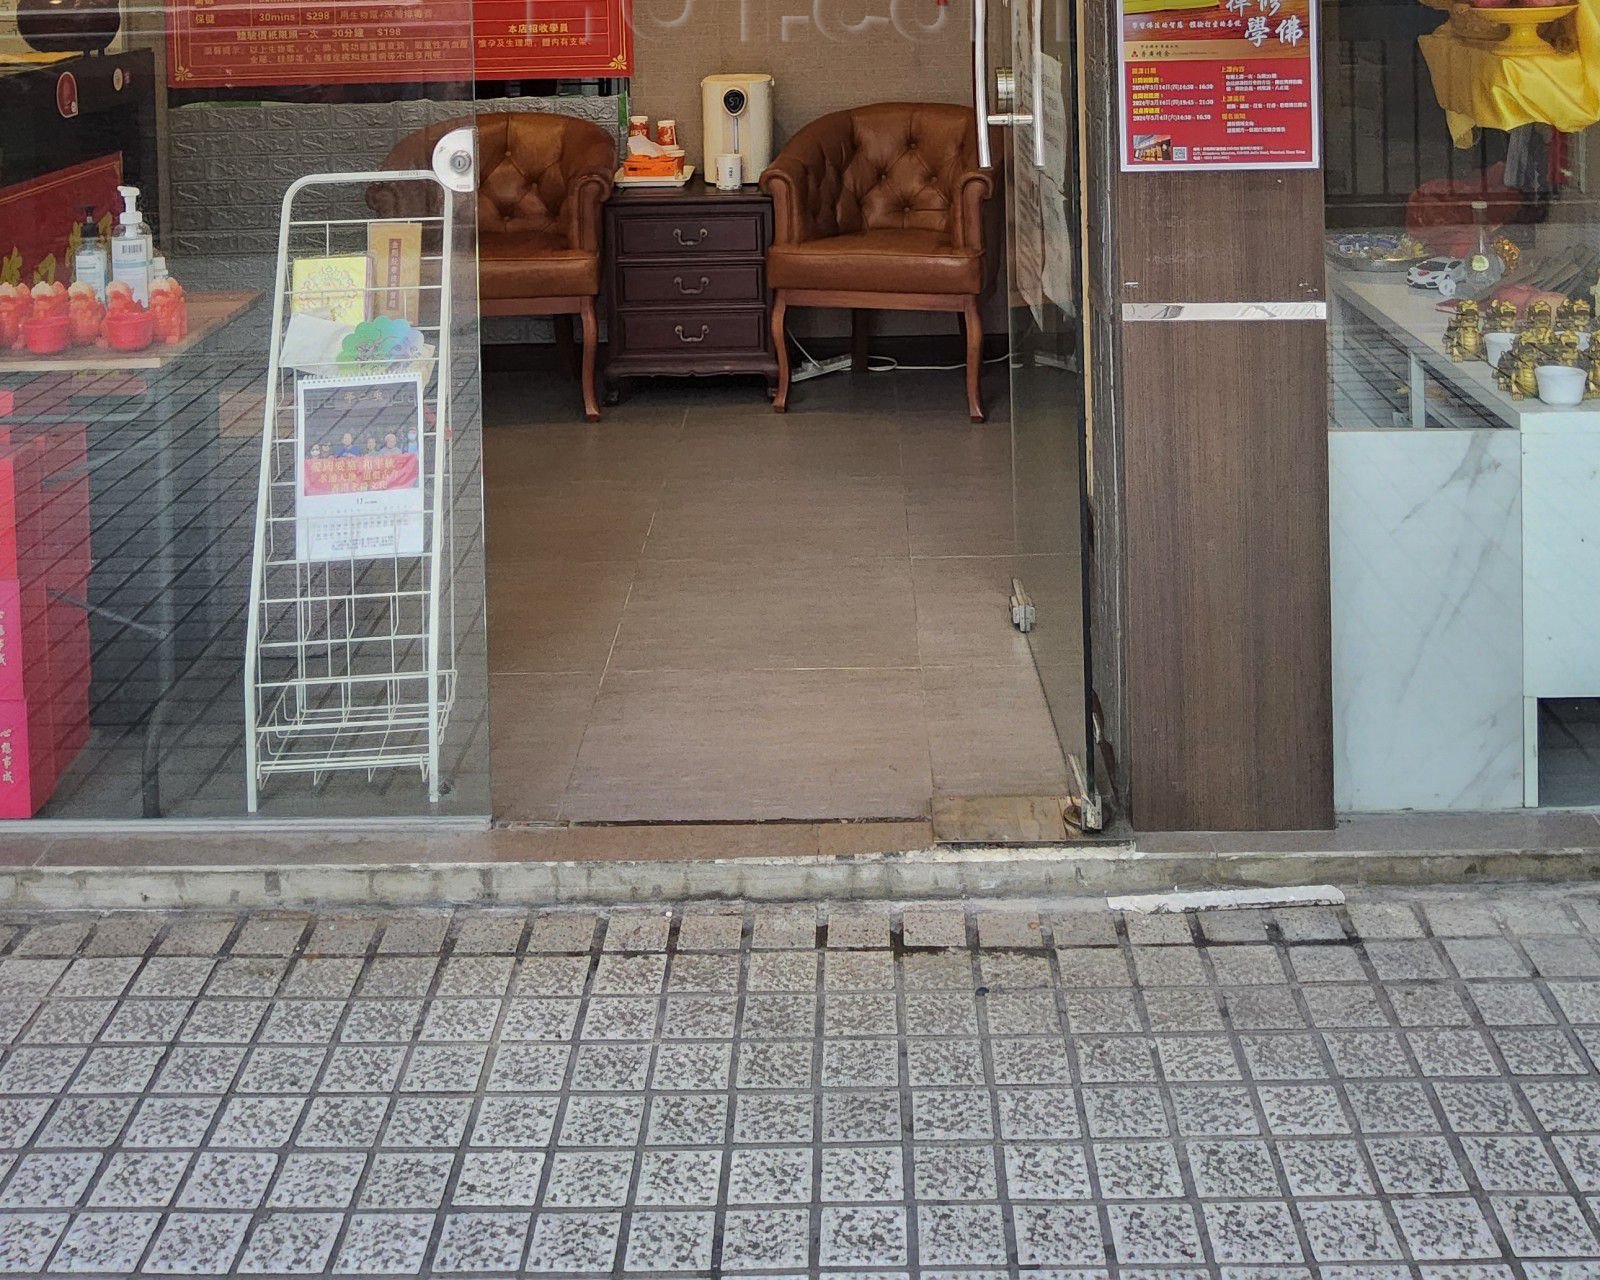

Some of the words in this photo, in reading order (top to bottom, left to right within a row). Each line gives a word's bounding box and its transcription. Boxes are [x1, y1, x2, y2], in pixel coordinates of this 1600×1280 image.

[259, 13, 296, 22] 30mins
[306, 11, 330, 21] $298
[377, 27, 401, 36] $198
[1245, 15, 1303, 48] 學佛
